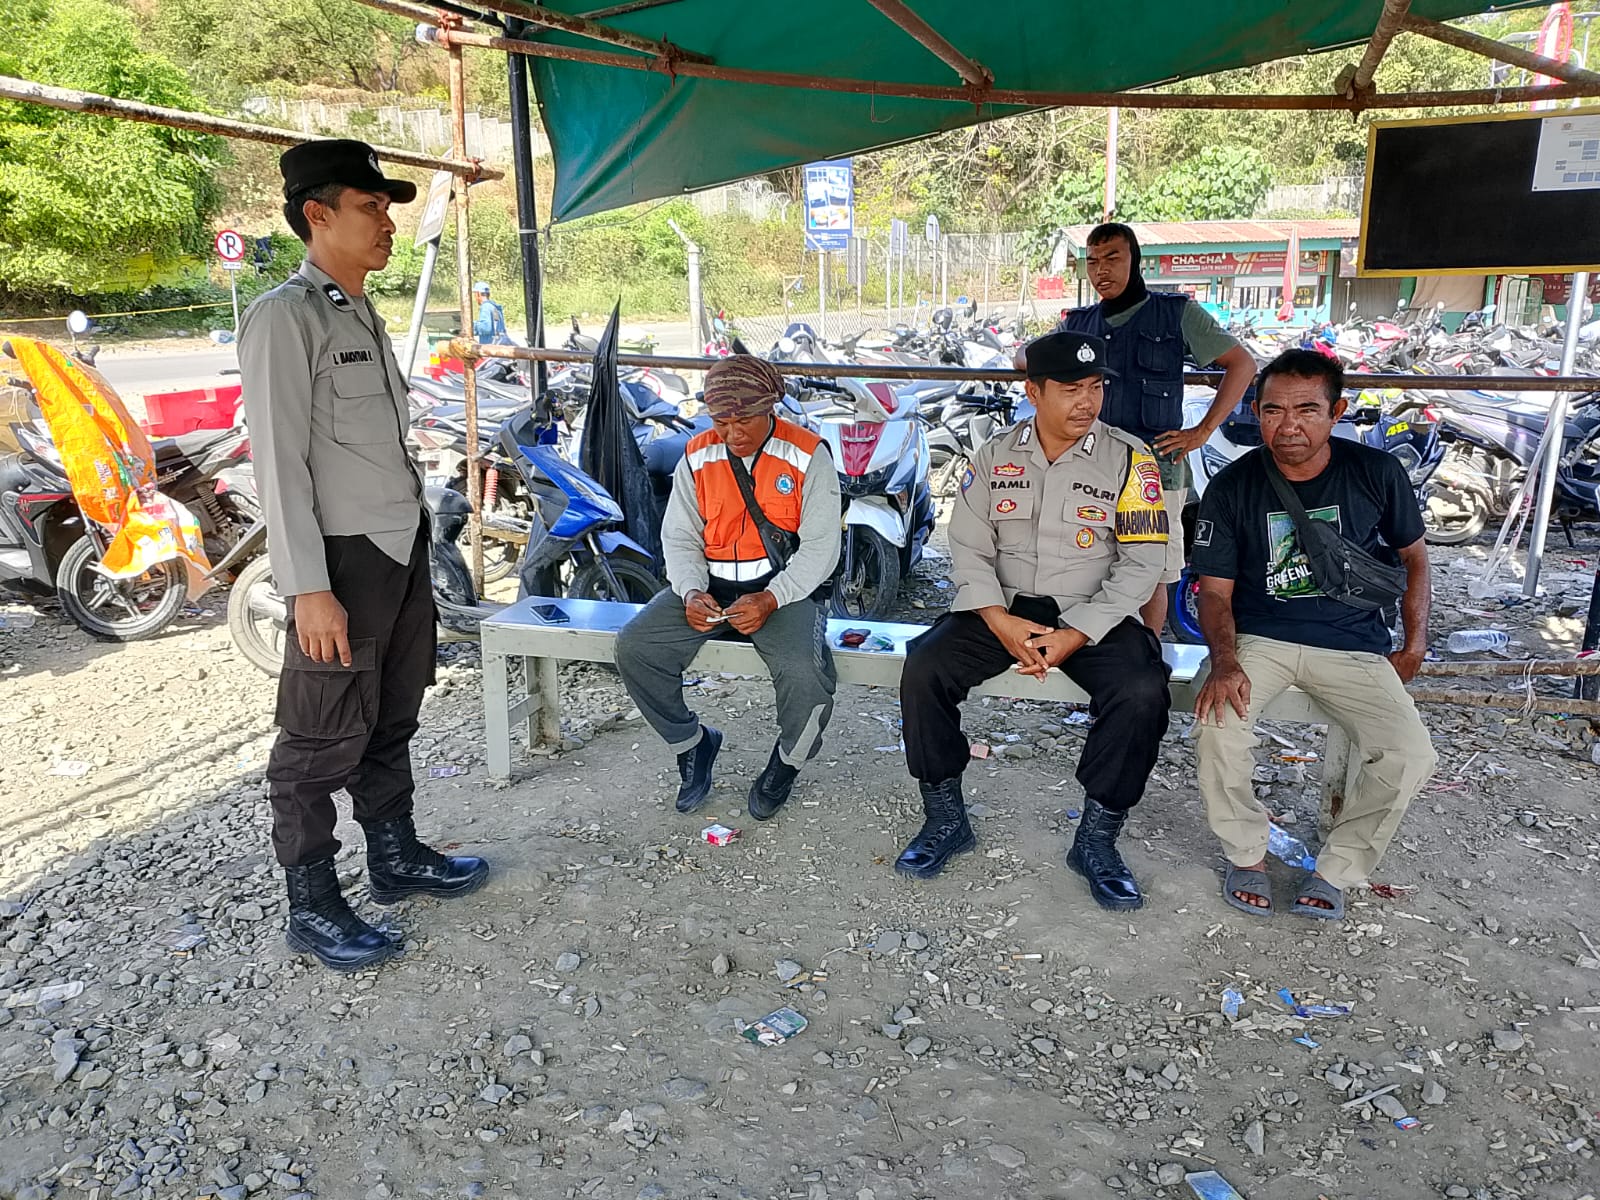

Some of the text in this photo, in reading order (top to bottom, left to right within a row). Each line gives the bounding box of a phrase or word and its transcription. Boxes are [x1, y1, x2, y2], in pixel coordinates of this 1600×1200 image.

[1171, 255, 1223, 265] CHA-CHA
[991, 480, 1030, 490] RAMLI
[1072, 482, 1115, 501] POLRI
